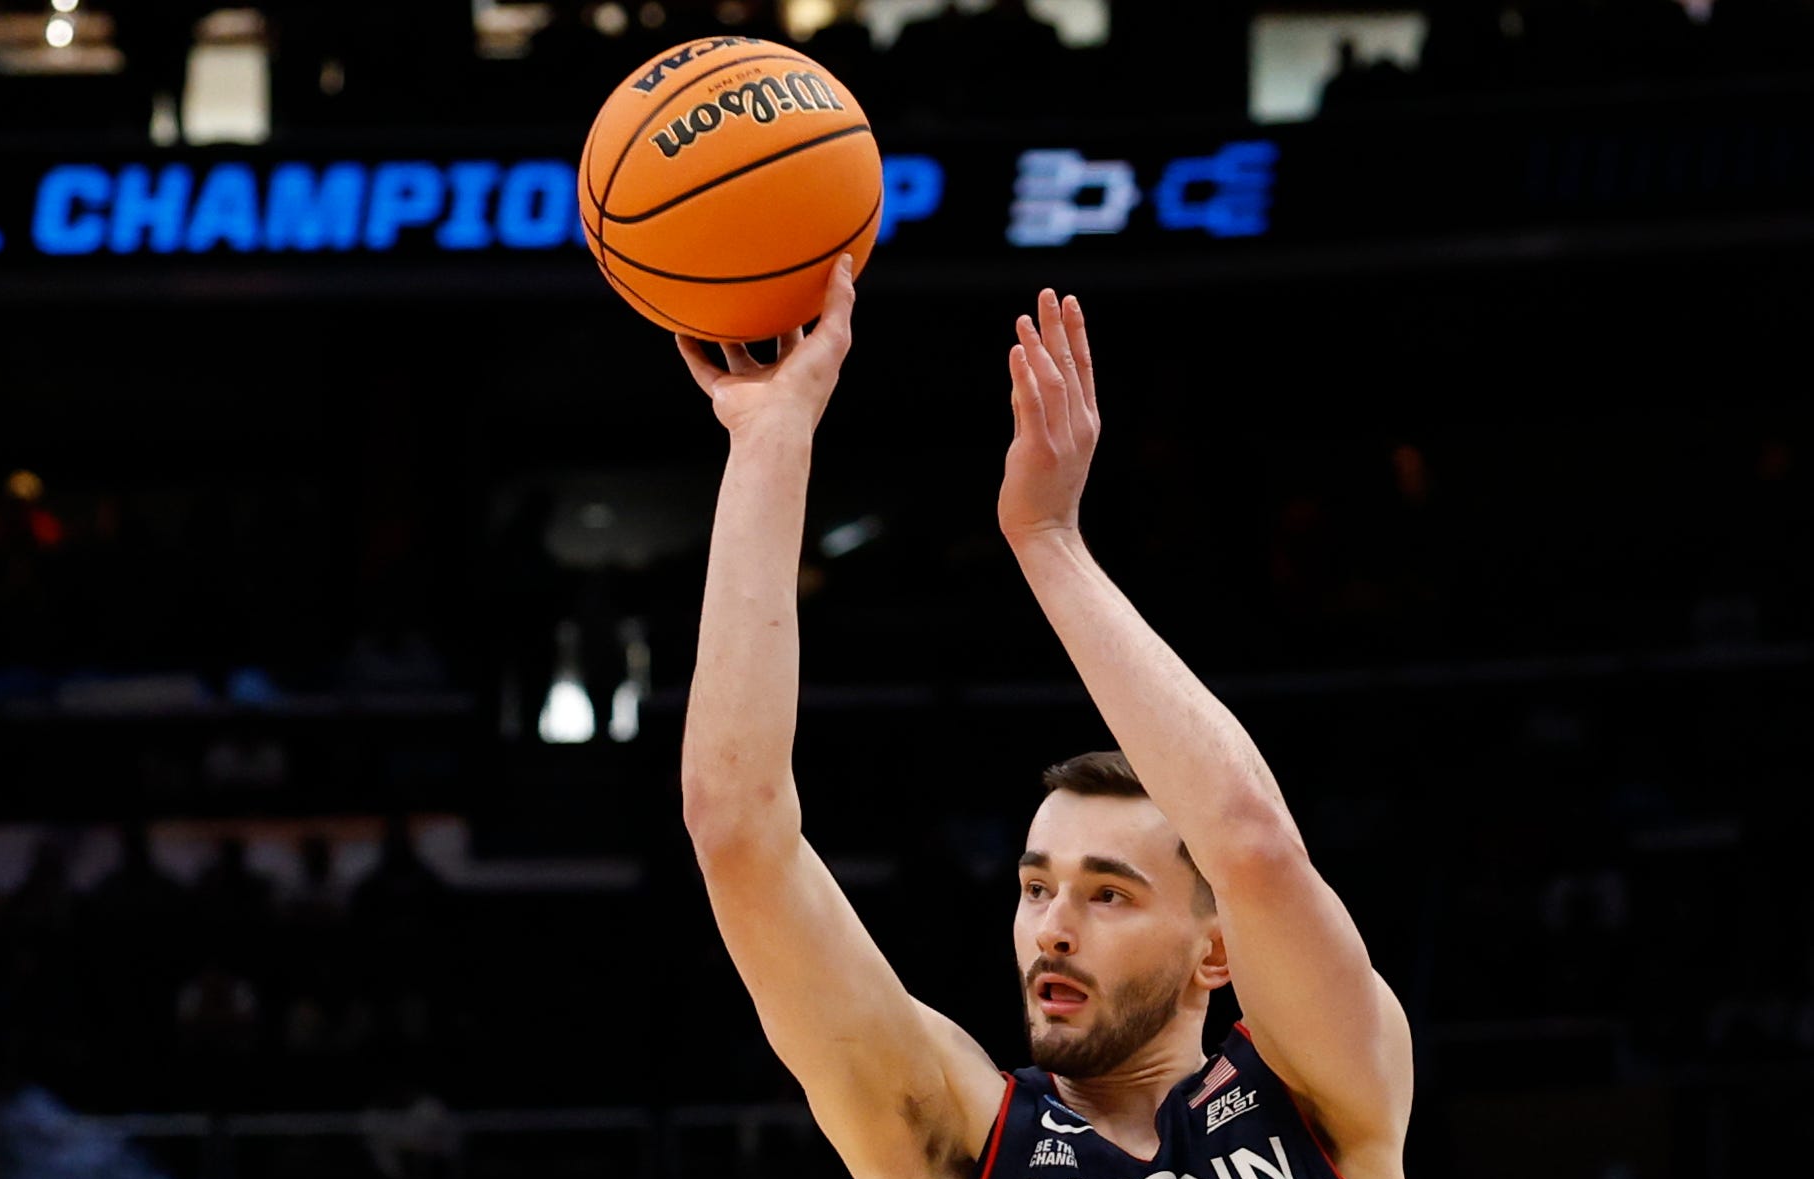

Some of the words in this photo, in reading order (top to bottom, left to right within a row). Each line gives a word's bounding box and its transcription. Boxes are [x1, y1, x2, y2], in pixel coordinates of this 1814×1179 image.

[649, 72, 844, 158] Wilson
[30, 158, 944, 255] CHAMPIOP
[1207, 1086, 1241, 1116] BIG
[1207, 1090, 1257, 1127] EAST
[1034, 1139, 1053, 1153] BE
